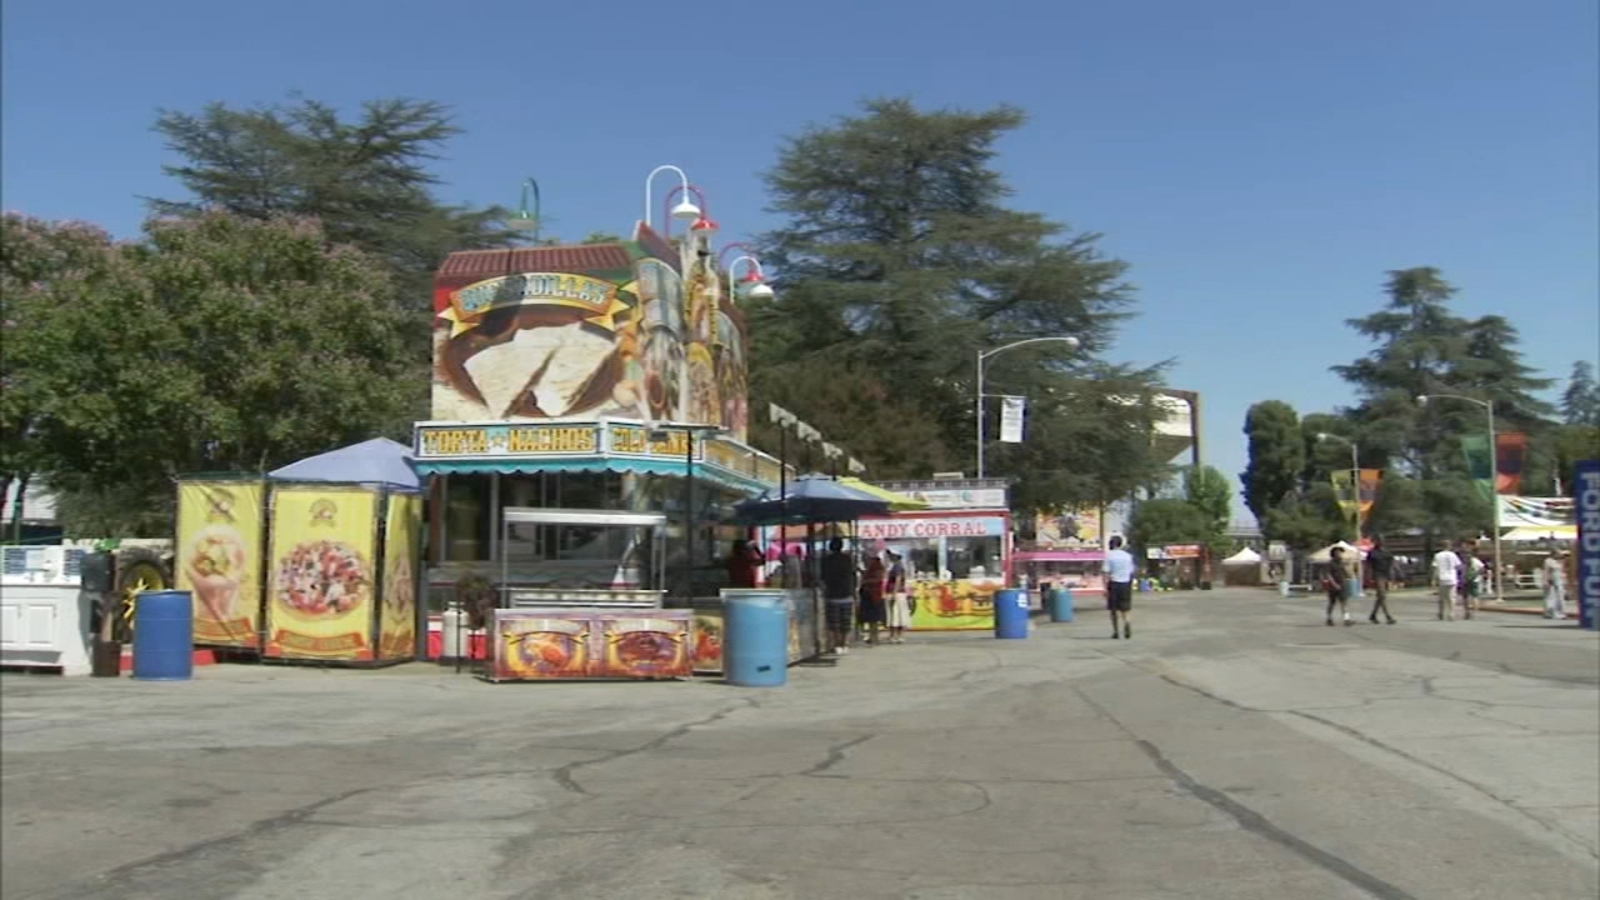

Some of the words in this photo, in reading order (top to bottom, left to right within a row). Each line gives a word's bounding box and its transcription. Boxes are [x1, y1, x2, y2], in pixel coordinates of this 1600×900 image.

[424, 429, 487, 453] TORTA
[508, 428, 594, 452] NACHOS
[1580, 472, 1600, 552] FORD
[861, 522, 909, 538] ANDY
[914, 521, 987, 536] CORRAL
